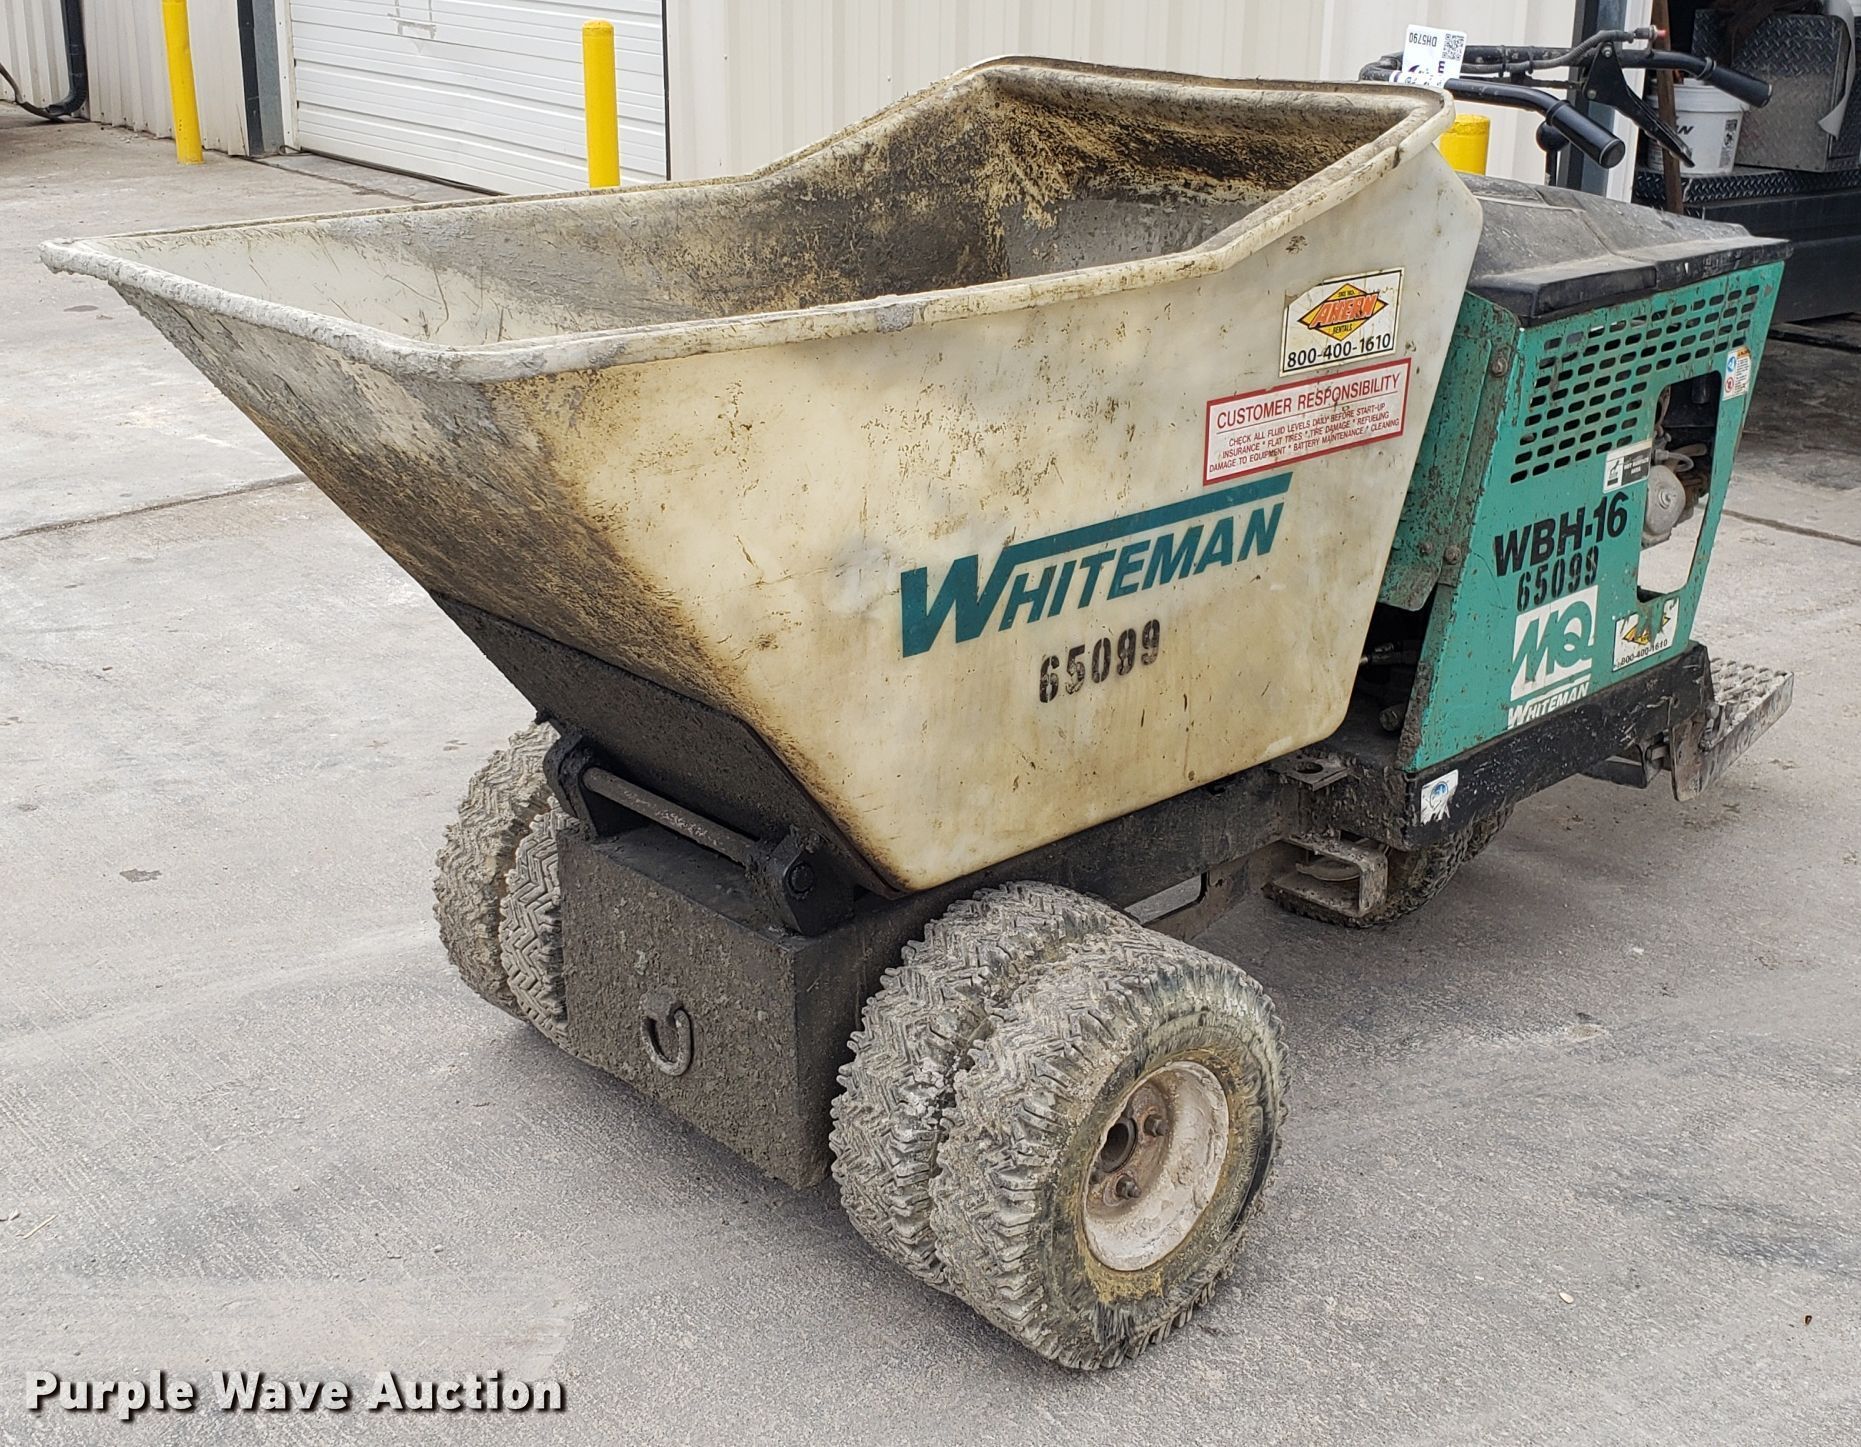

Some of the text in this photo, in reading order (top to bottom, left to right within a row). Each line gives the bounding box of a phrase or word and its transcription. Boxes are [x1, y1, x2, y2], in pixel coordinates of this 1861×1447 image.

[1409, 32, 1437, 47] DH5790
[1287, 332, 1391, 368] 800-400-1610
[1216, 372, 1400, 430] CUSTOMER RESPONSIBILITY
[1228, 434, 1251, 447] CHECK
[1253, 431, 1265, 441] ALL
[1267, 426, 1286, 438] FLUID
[1287, 419, 1311, 433] LEVELS
[1330, 409, 1355, 422] BEFORE
[1356, 402, 1386, 417] START-UP
[1209, 418, 1400, 473] DAMAGE TO EQUIPMENT BATTERY MAINTENANCE CLEANING
[1222, 411, 1390, 459] INSURANCE FLAT TIRES TIRE DAMAGE REFUELING
[1493, 490, 1629, 577] WBH-16
[900, 471, 1293, 659] WHITEMAN
[1515, 544, 1600, 612] 65099
[1038, 618, 1161, 703] 65099
[1512, 590, 1598, 695] MQ
[1507, 674, 1592, 731] WHITEMAN
